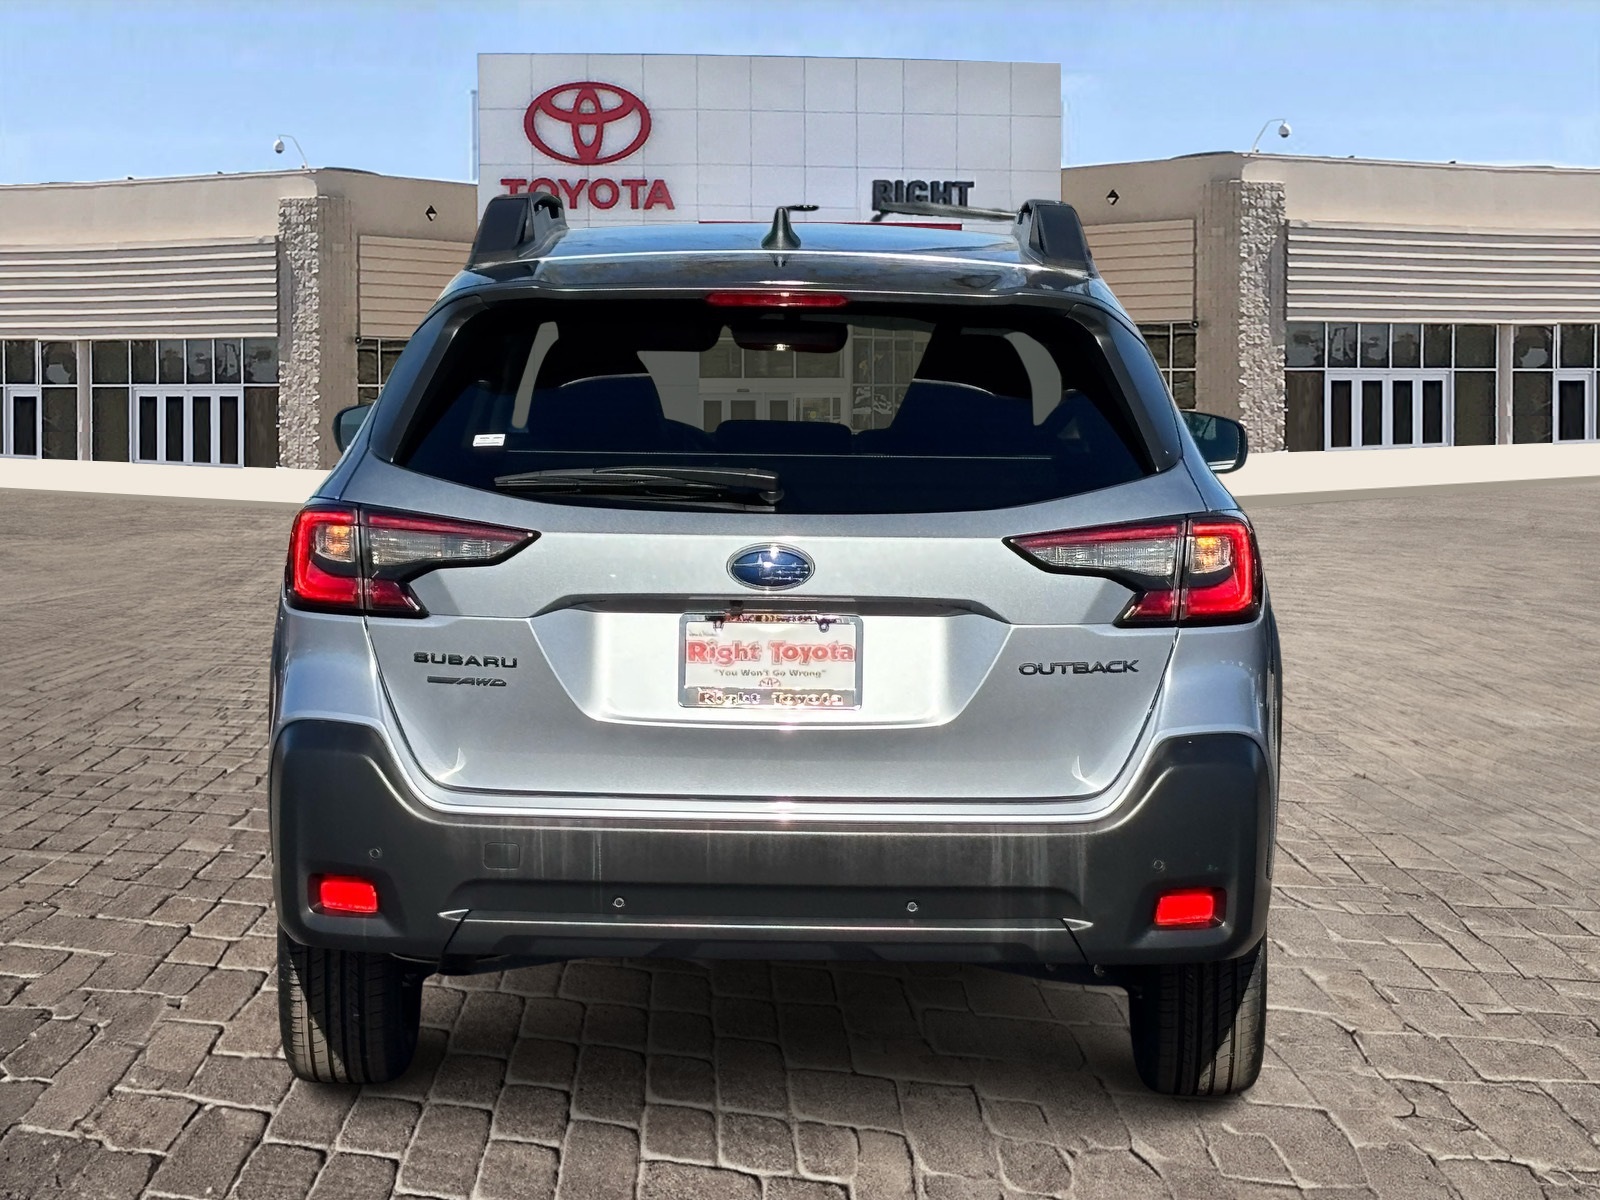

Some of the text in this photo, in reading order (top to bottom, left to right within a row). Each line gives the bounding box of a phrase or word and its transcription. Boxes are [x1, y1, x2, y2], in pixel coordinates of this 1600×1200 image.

[500, 178, 676, 210] TOYOTA
[872, 179, 975, 211] RIGHT
[413, 651, 518, 668] SUBARU
[686, 639, 856, 667] Right Toyota
[741, 669, 769, 677] Won't
[772, 669, 786, 677] Go
[1018, 659, 1139, 675] OUTBACK
[455, 676, 507, 687] AWD
